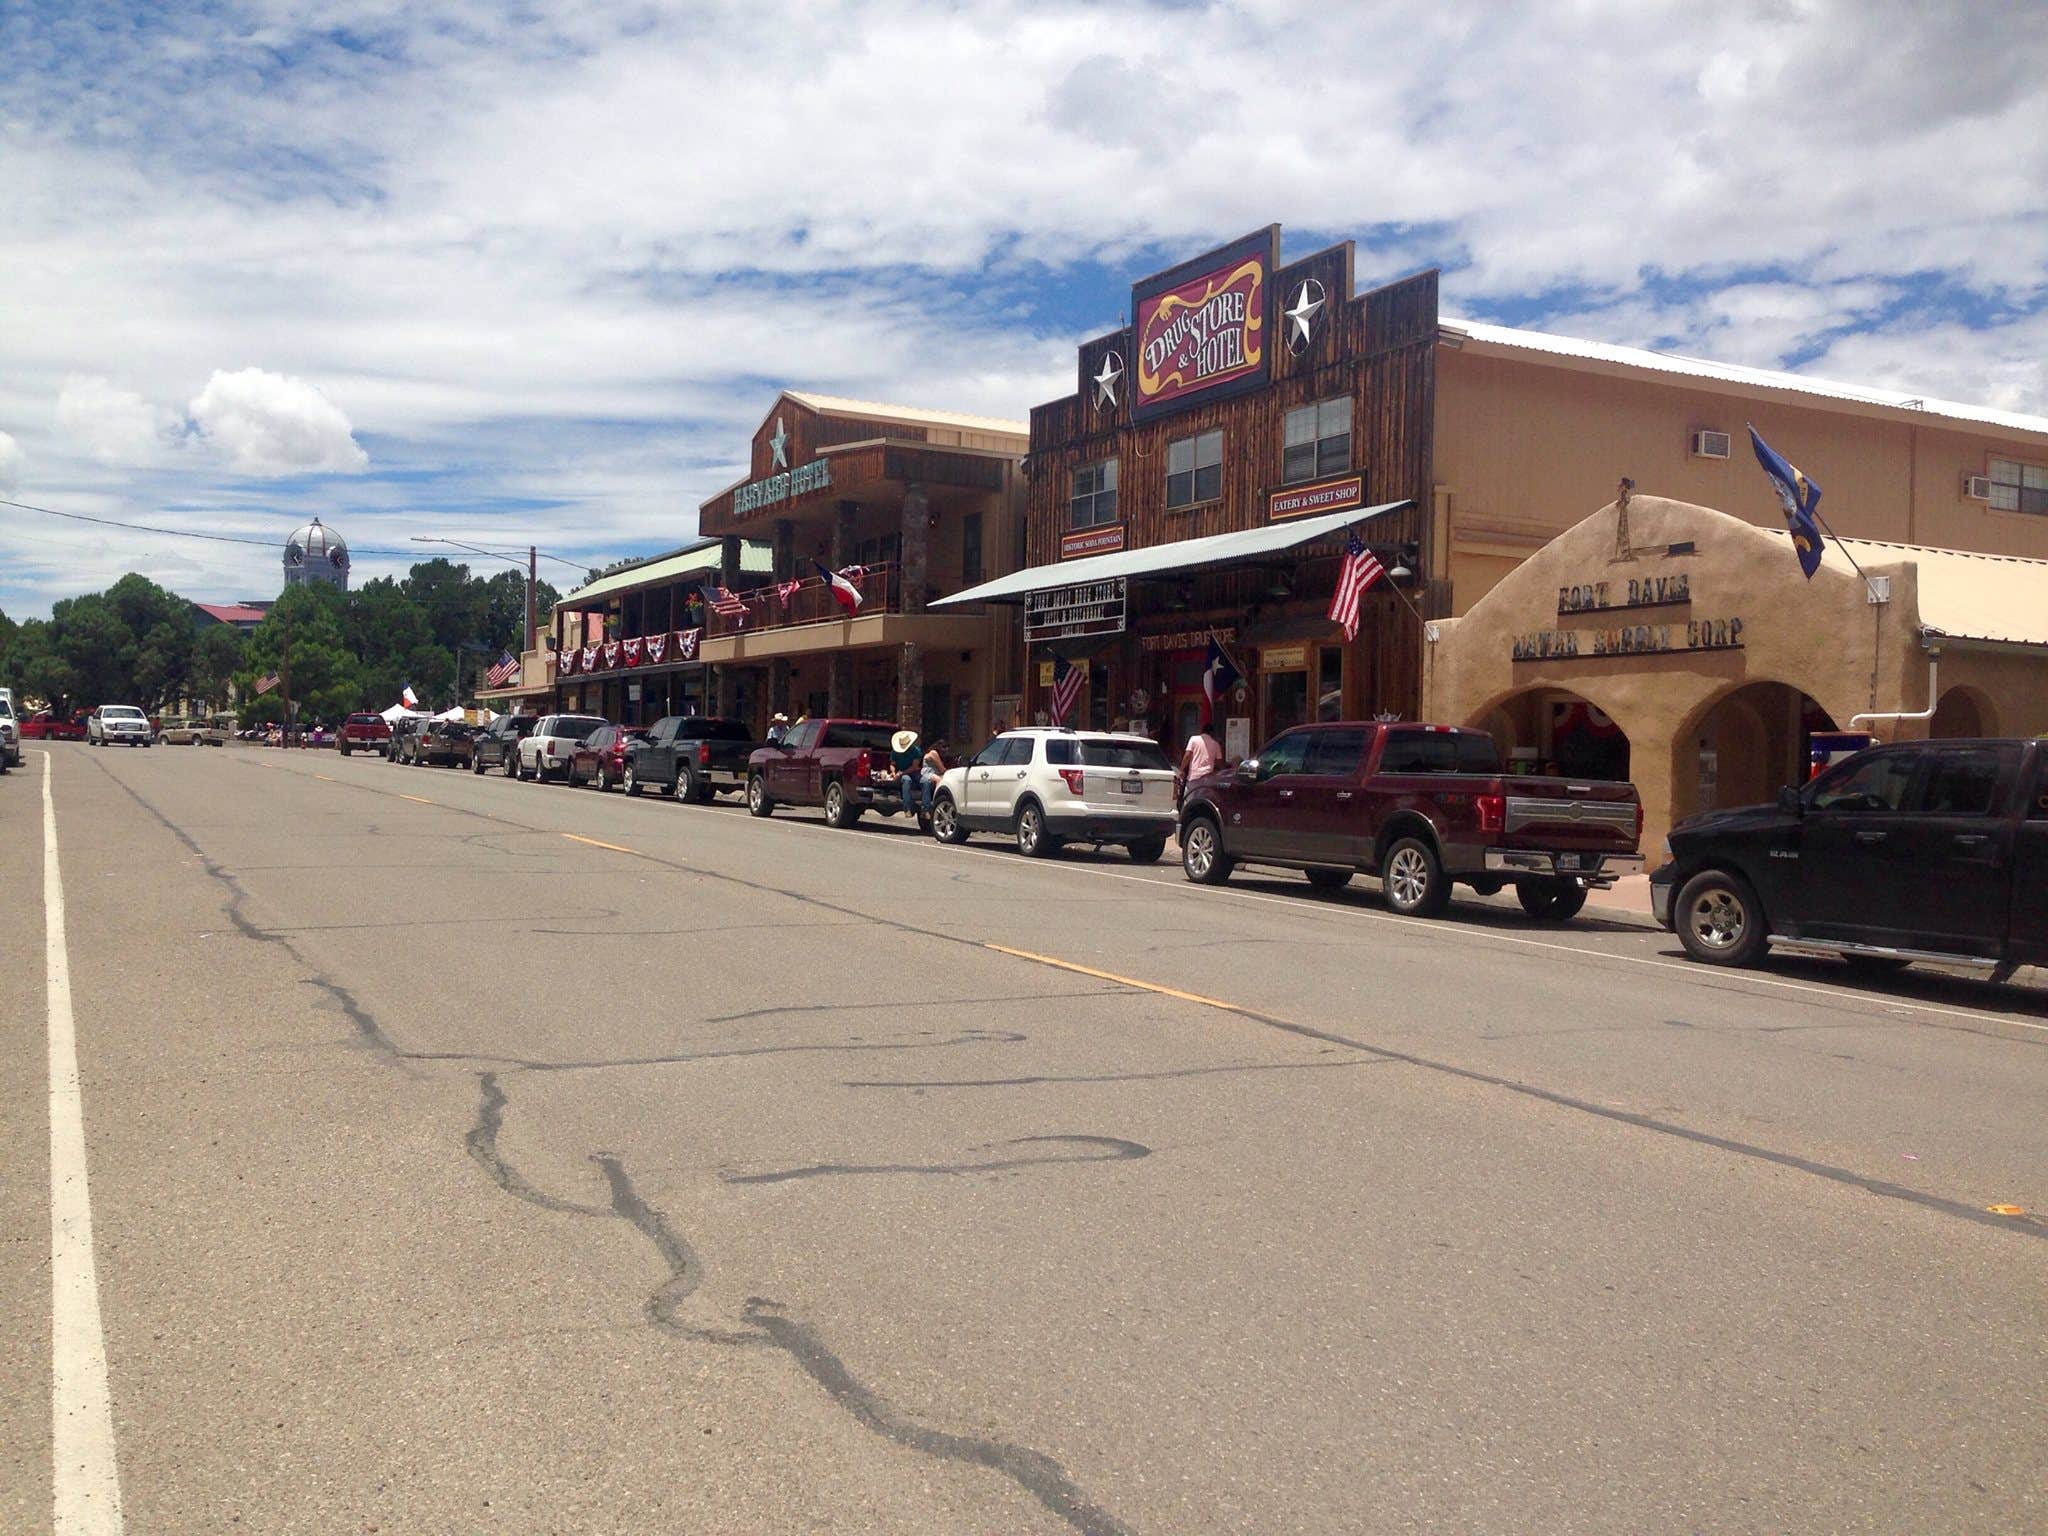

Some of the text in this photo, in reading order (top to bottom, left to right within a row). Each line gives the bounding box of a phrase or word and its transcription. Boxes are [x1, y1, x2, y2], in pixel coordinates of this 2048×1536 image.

[1145, 292, 1245, 373] DRUG STORE
[1178, 327, 1245, 378] & HOTEL
[790, 457, 833, 497] HOTEL
[1273, 486, 1358, 512] EATERY & SWEET SHOP
[1558, 573, 1690, 612] FORT DAVIS
[1687, 616, 1744, 648] CORP
